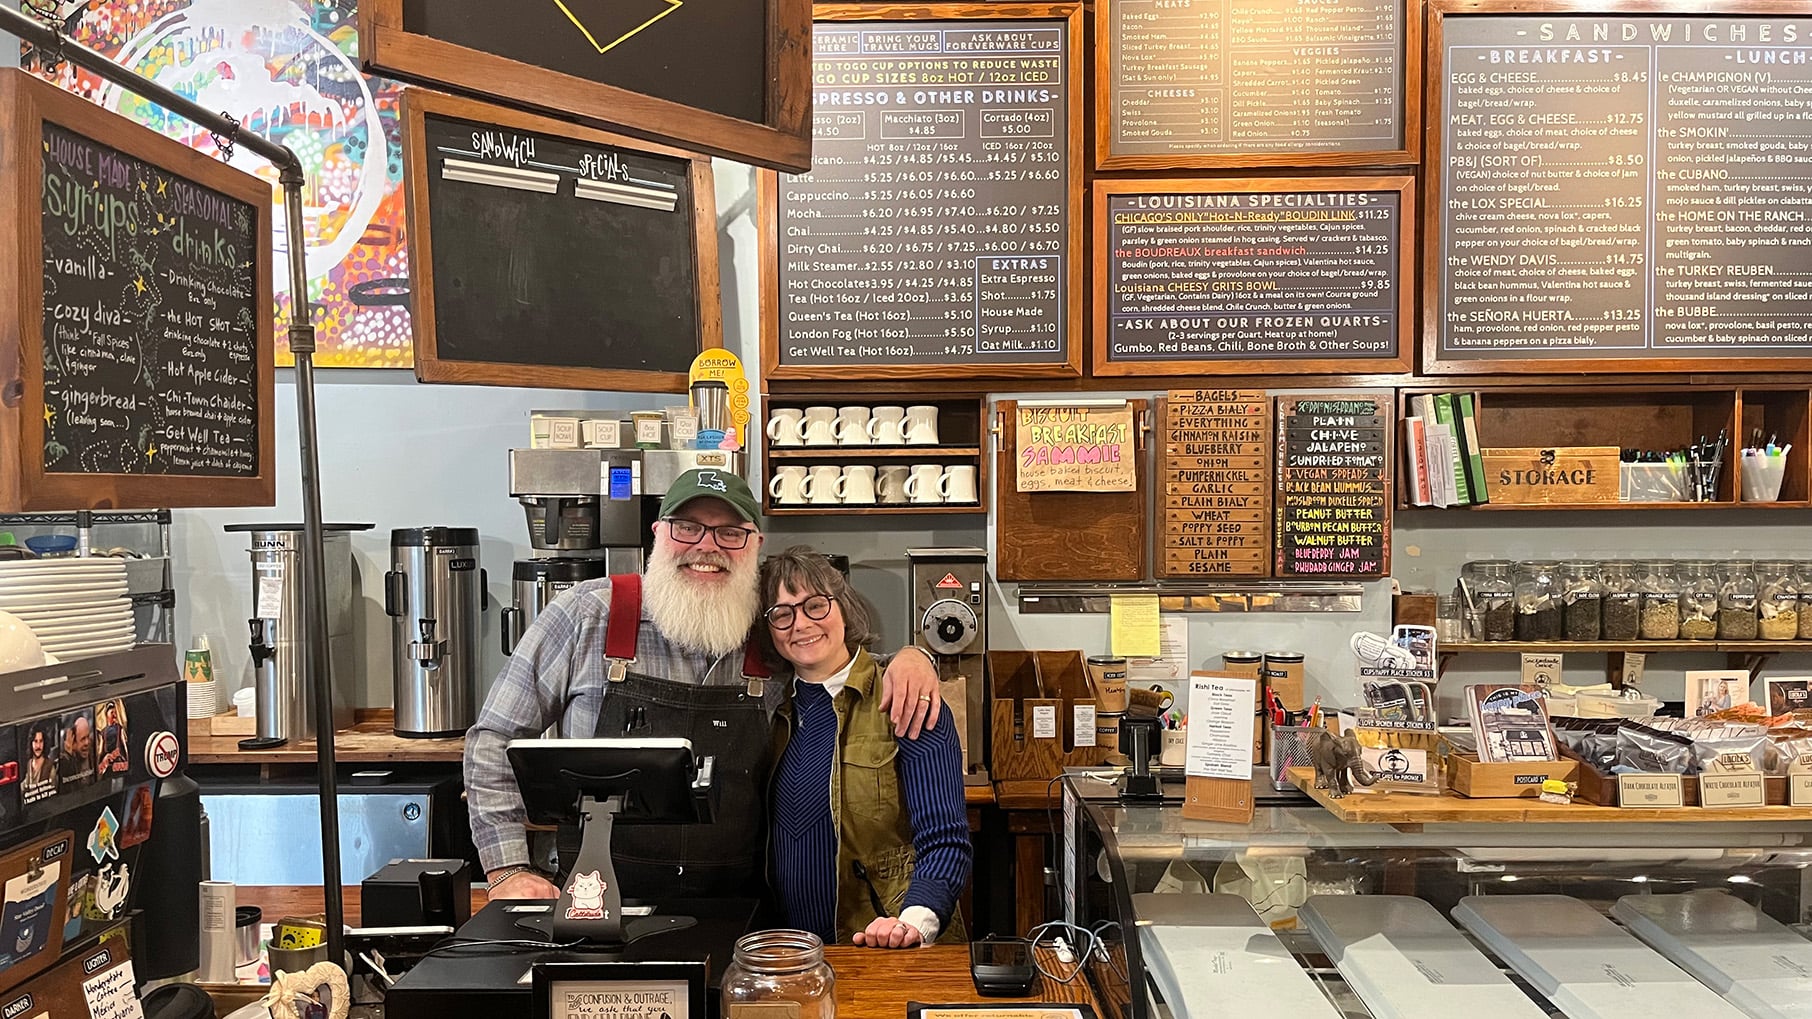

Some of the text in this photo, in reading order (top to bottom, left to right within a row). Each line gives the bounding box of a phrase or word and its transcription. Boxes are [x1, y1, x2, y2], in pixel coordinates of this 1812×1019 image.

[868, 35, 937, 43] BRING YOUR
[971, 34, 992, 42] ASK
[864, 42, 939, 51] TRAVEL MUGS
[946, 41, 1059, 50] FOREVERWARE CUPS
[1293, 47, 1339, 56] VEGGIES
[842, 73, 871, 83] CUP
[876, 73, 916, 83] SIZES
[922, 73, 944, 82] 8oz
[949, 72, 974, 82] HOT
[978, 72, 984, 83] /
[989, 72, 1016, 82] 12oz
[1020, 72, 1048, 81] ICED
[896, 92, 907, 104] &
[914, 91, 975, 104] OTHER
[1148, 89, 1195, 98] CHEESES
[50, 133, 131, 191] HOUSE MADE
[174, 182, 232, 230] SEASONAL
[48, 173, 138, 262] syrups
[173, 216, 236, 269] drinks
[992, 259, 1047, 270] EXTRAS
[982, 274, 1055, 285] Extra Espresso
[185, 312, 202, 328] HOT
[1160, 318, 1210, 329] ABOUT
[1218, 318, 1248, 328] OUR
[1256, 317, 1312, 327] FROZEN
[1114, 340, 1388, 353] Gumbo, Red Beans, Chili, Bone Broth & Other Soups!
[699, 359, 736, 367] BORROW
[188, 364, 211, 386] Apple
[1196, 391, 1237, 401] BAGELS
[1180, 405, 1248, 415] PIZZA BIALY
[1180, 418, 1248, 428] EVERYTHING
[1313, 416, 1354, 426] PLAIN
[188, 427, 208, 443] Well
[1031, 423, 1127, 446] BREAKFAST
[1222, 430, 1259, 441] RAISIN
[1311, 430, 1359, 440] CHIVE
[1186, 444, 1242, 454] BLUEBERRY
[1022, 444, 1120, 467] SAMMIE
[1197, 459, 1228, 467] ONION
[1290, 456, 1343, 466] SUNDRIED
[1020, 468, 1045, 478] house
[1050, 465, 1080, 474] baked
[1179, 471, 1248, 481] PUMPERNICKEL
[1296, 469, 1368, 479] VEGAN SPREADS
[1055, 476, 1082, 485] meat
[1500, 469, 1596, 486] STORAGE
[1192, 484, 1233, 493] GARLIC
[1182, 497, 1248, 506] PLAIN BIALY
[1192, 511, 1230, 520] WHEAT
[1296, 509, 1372, 519] PEANUT BUTTER
[1182, 524, 1241, 533] POPPY SEED
[1179, 537, 1245, 546] SALT & POPPY
[1294, 535, 1373, 546] WALNUT BUTTER
[1194, 550, 1227, 559] PLAIN
[1340, 549, 1359, 559] JAM
[1189, 562, 1231, 572] SESAME
[156, 749, 177, 763] TRUMP
[583, 994, 621, 1004] CONFUSION
[624, 994, 632, 1004] &
